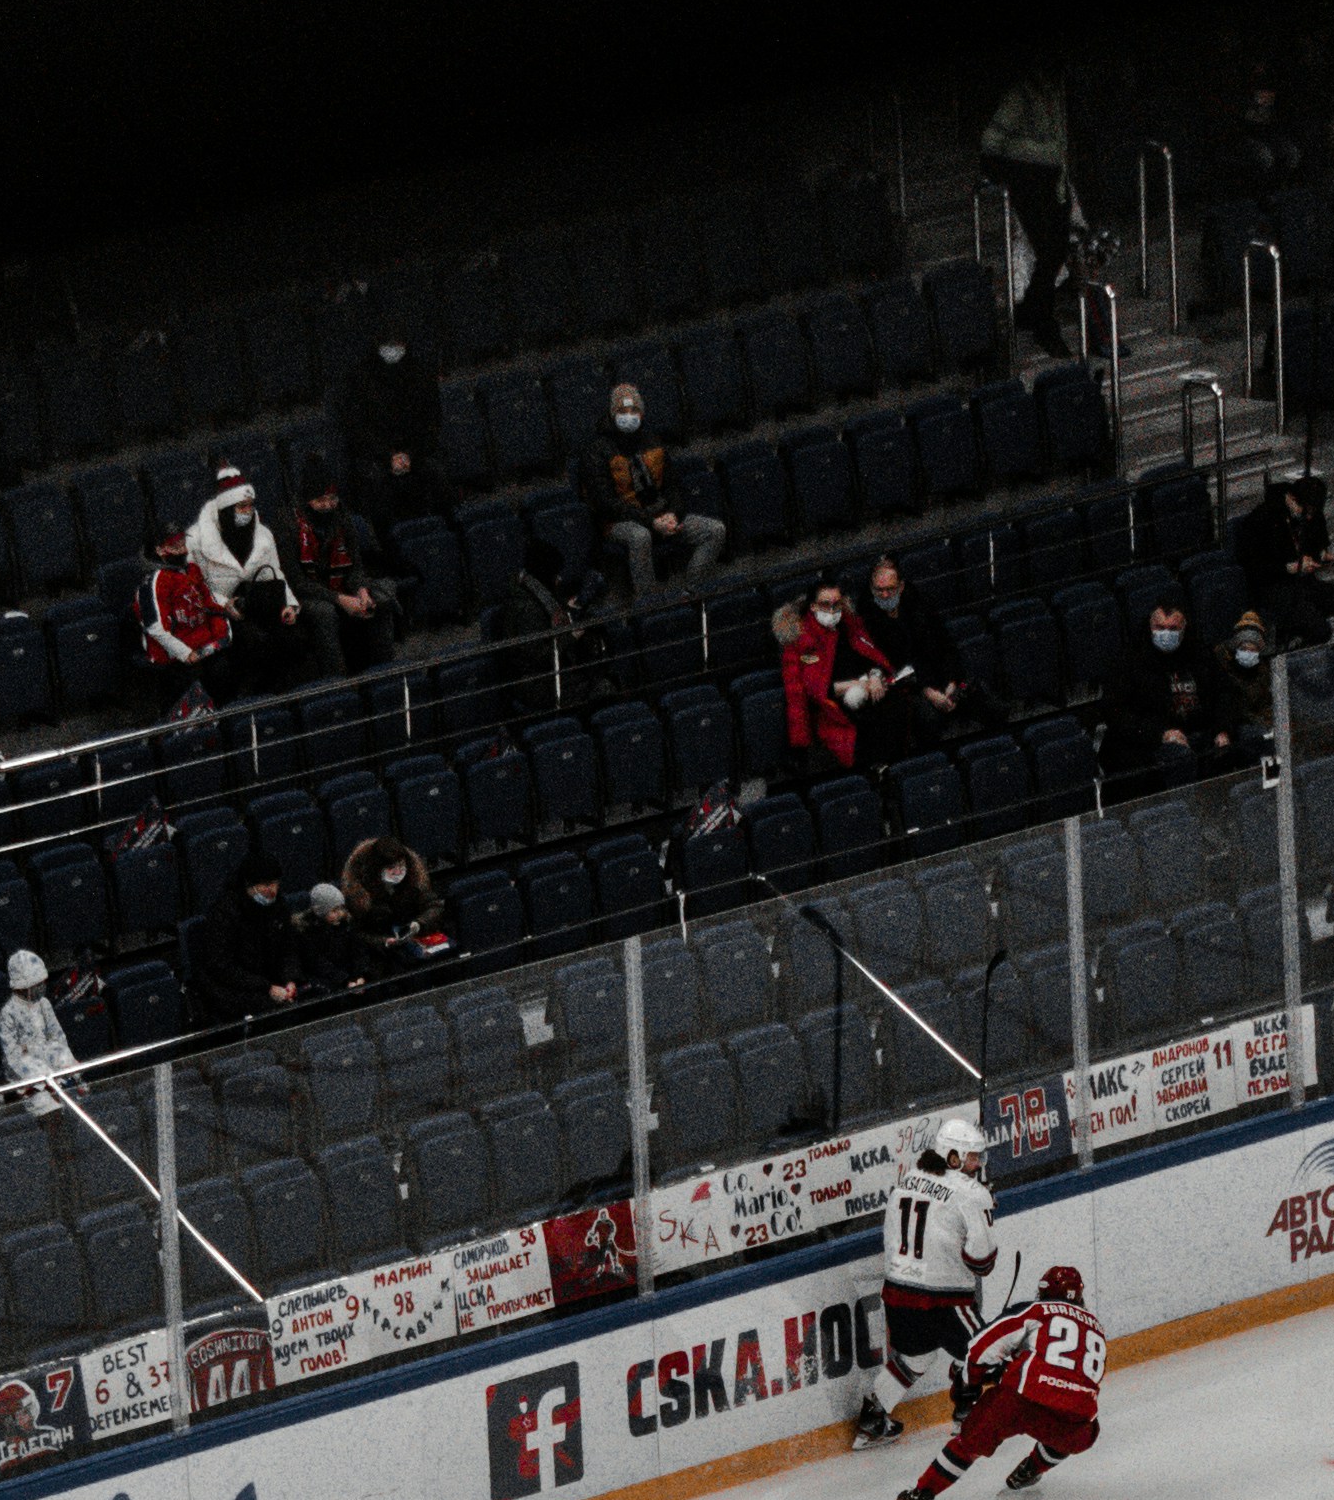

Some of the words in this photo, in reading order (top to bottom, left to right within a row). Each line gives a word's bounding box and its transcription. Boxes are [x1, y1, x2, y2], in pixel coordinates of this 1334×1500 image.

[1152, 1037, 1209, 1069] АНДРОНОВ
[1250, 1054, 1286, 1078] БУДЕ
[1161, 1055, 1206, 1086] СЕРГЕЙ
[1247, 1072, 1292, 1095] ПЕРВЫ
[1156, 1076, 1208, 1106] ЗАБИВАЙ
[1166, 1097, 1210, 1122] СКОРЕЙ
[1069, 1112, 1105, 1139] НЕН
[807, 1139, 852, 1162] ТОЛЬКО
[783, 1159, 807, 1181] 23
[810, 1179, 852, 1205] ТОЛЬКО
[845, 1186, 895, 1216] ПОБЕД
[745, 1223, 769, 1246] 23
[898, 1197, 930, 1260] 11
[374, 1261, 432, 1288] МАМИН
[466, 1251, 532, 1285] ЗАЩИЩАЕТ
[394, 1291, 415, 1316] 98
[457, 1284, 495, 1312] ЦСКА
[460, 1313, 474, 1330] НЕ
[486, 1288, 554, 1320] ПРОПУСКАЕТ
[292, 1310, 333, 1335] АНТОН
[346, 1294, 360, 1320] 9
[102, 1341, 148, 1374] BEST
[300, 1340, 348, 1375] ГОЛОВ!
[1045, 1315, 1106, 1384] 28
[626, 1293, 884, 1437] CSKA.HOC
[45, 1367, 74, 1413] 7
[126, 1372, 144, 1398] &
